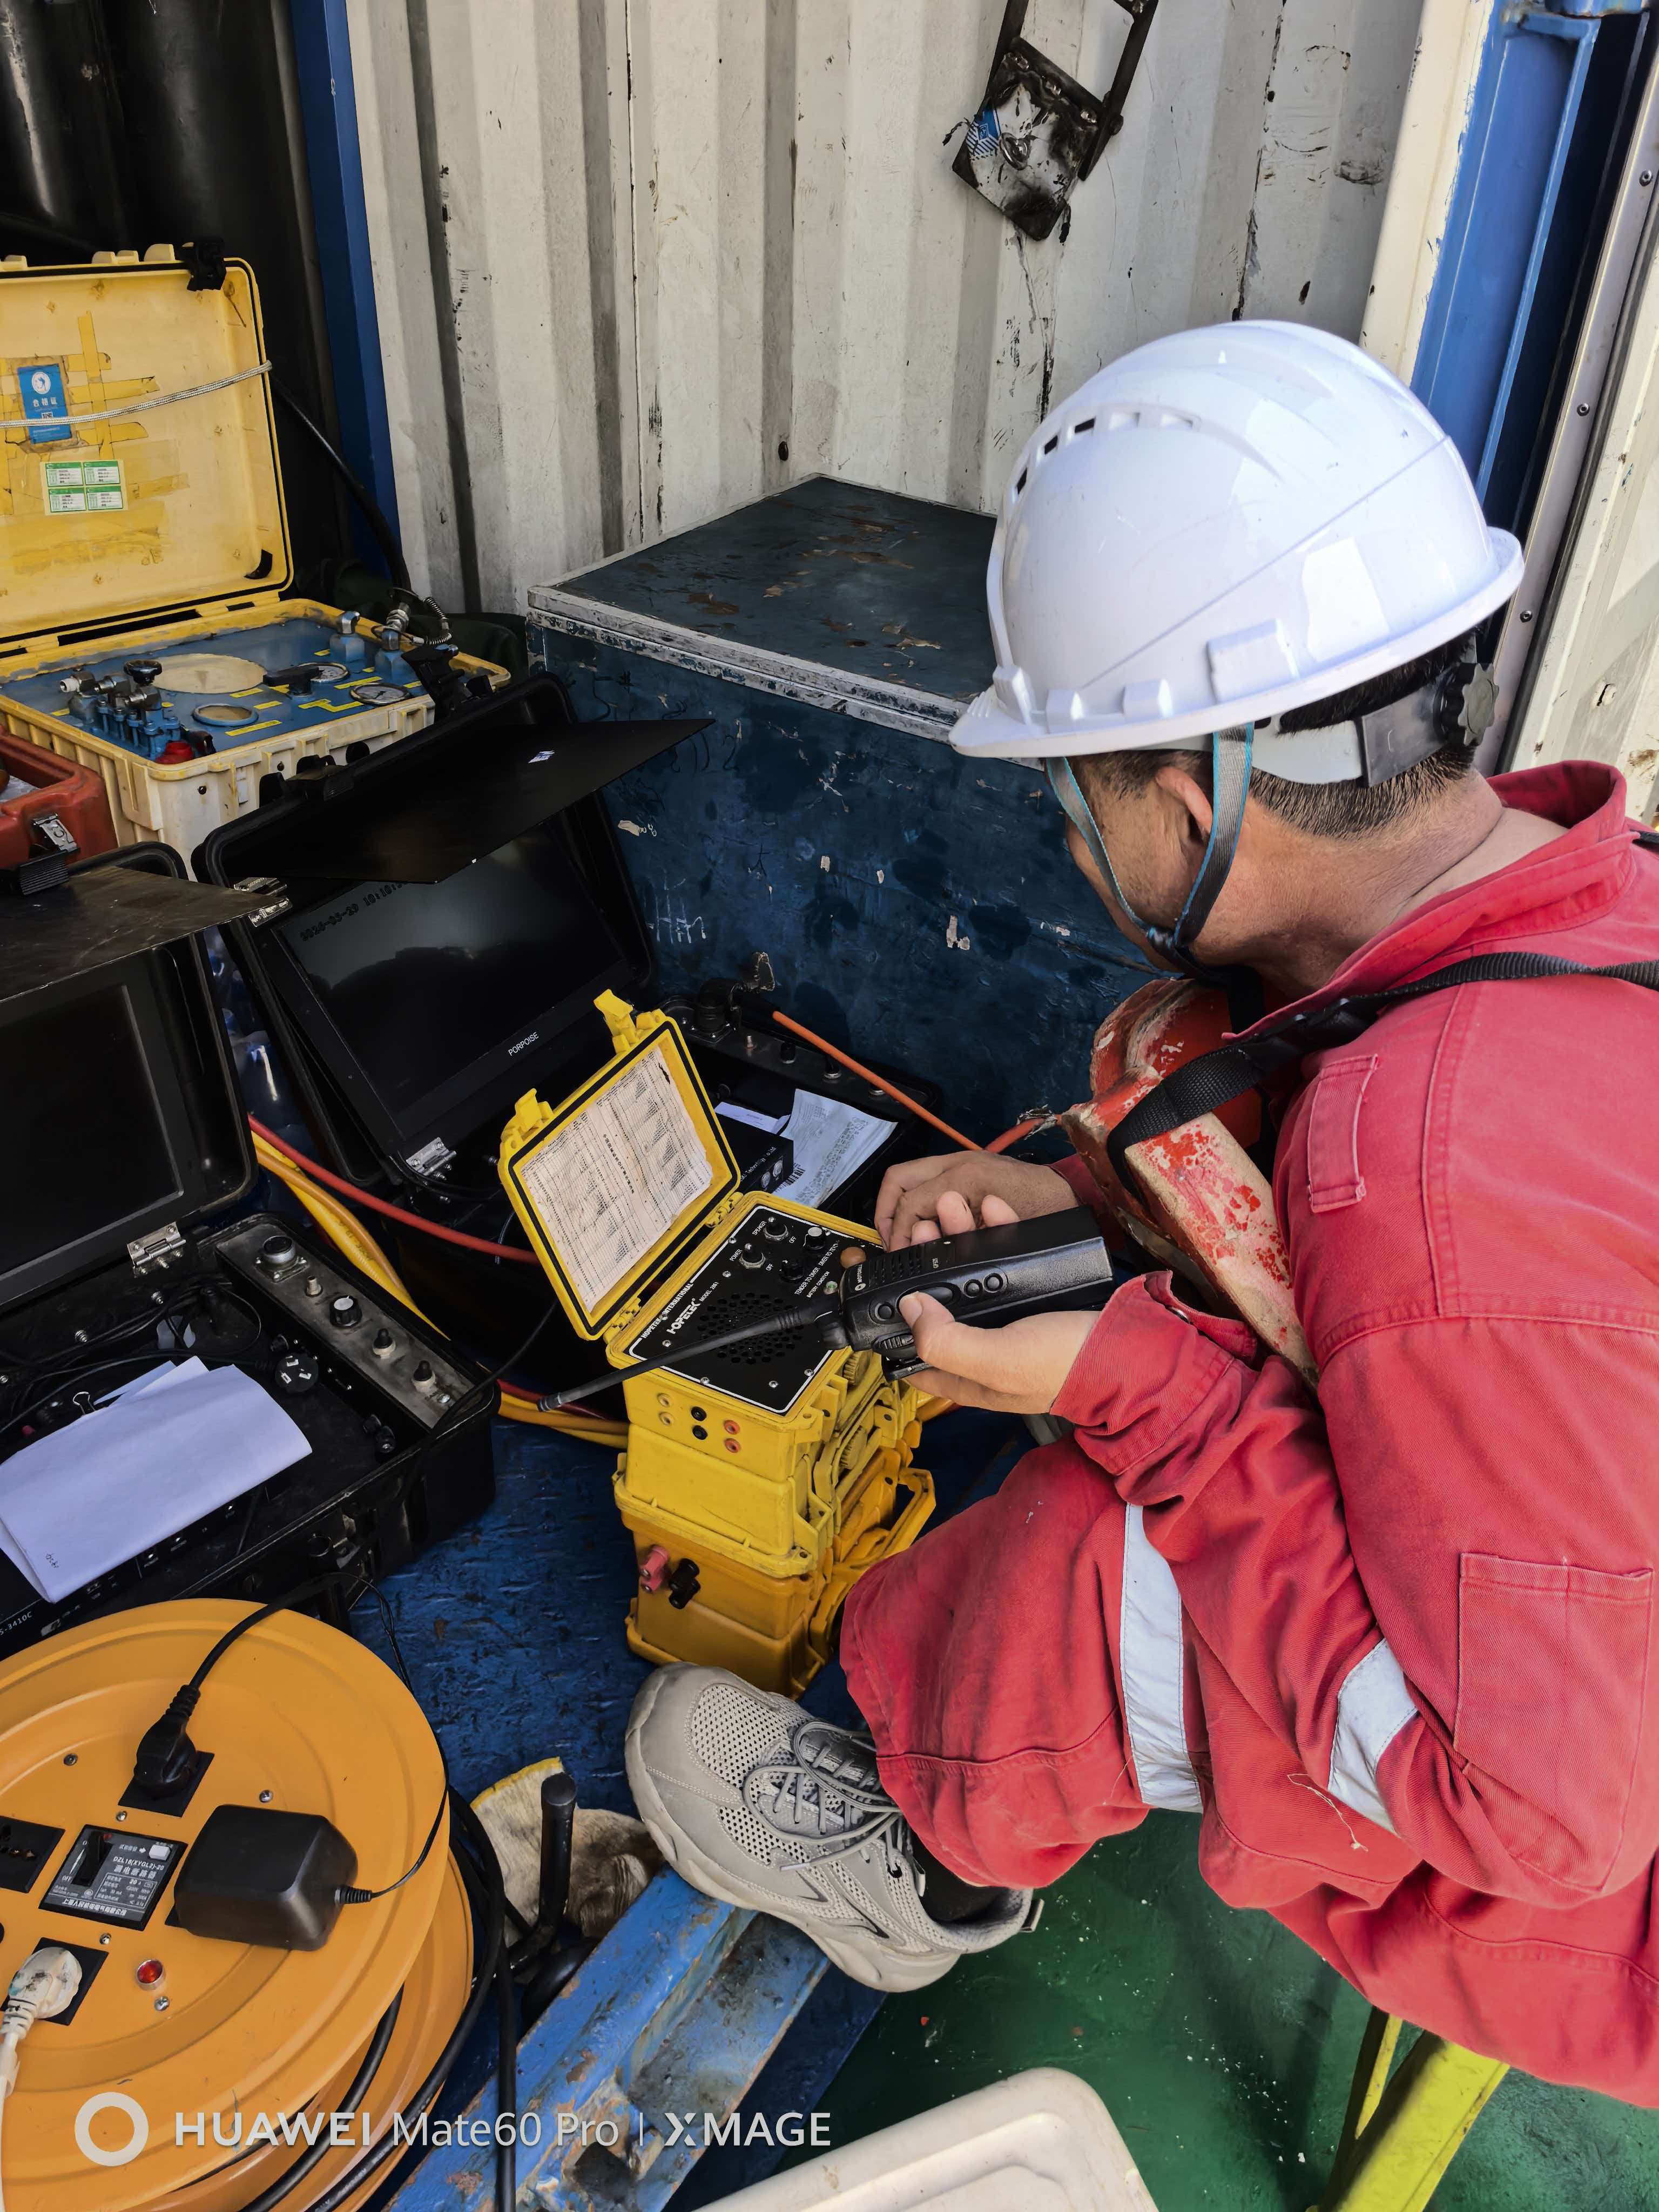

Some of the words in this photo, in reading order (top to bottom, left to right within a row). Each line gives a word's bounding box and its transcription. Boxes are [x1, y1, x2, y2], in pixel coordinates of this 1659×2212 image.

[508, 1031, 539, 1056] PORPOISE
[752, 1220, 767, 1235] SPEAKER
[730, 1249, 743, 1262] POWER
[818, 1256, 829, 1266] DIVER
[794, 1282, 808, 1294] TENDER
[809, 1267, 820, 1278] DIVER
[806, 1285, 819, 1298] BATTERY
[816, 1271, 830, 1286] CONDITION
[699, 1290, 712, 1302] MODEL
[642, 1318, 662, 1339] HOPETEK
[662, 1283, 693, 1317] INTERNATIONAL
